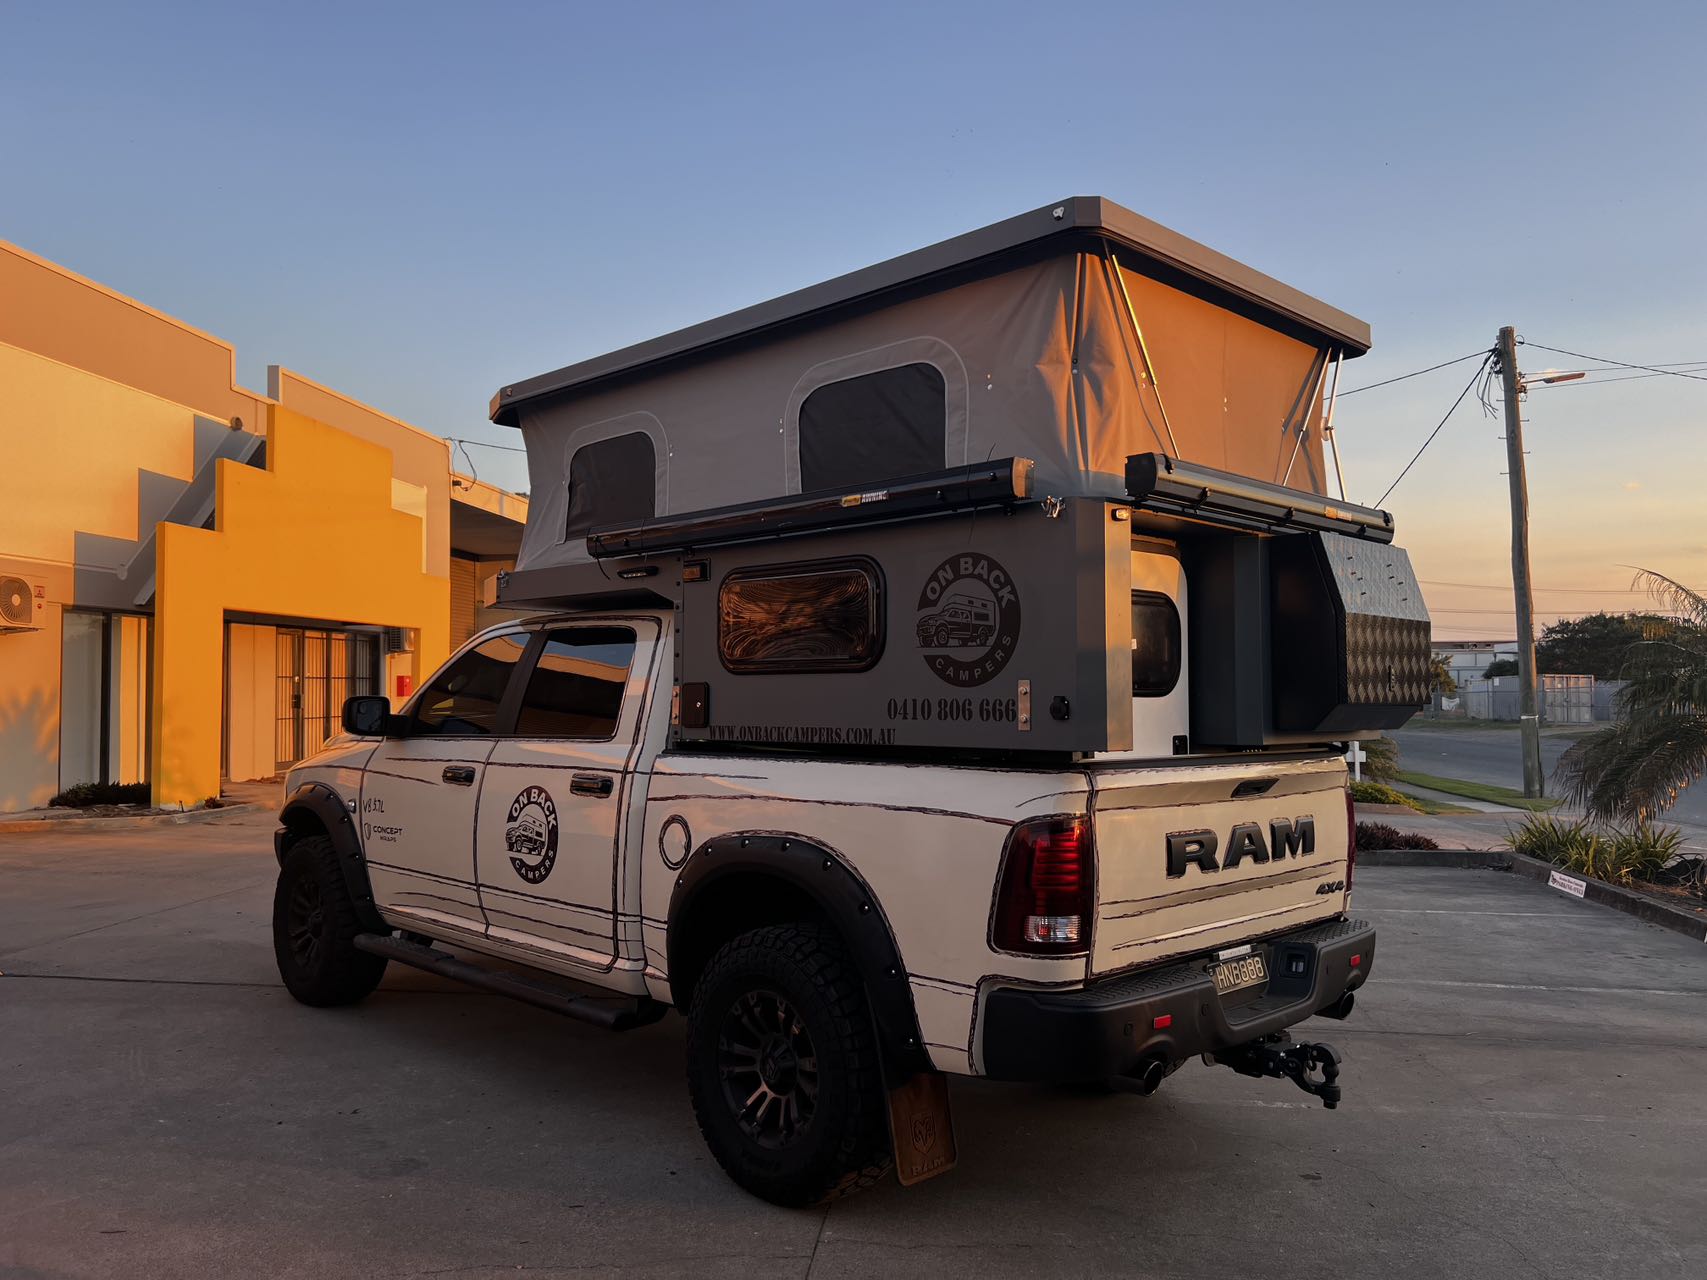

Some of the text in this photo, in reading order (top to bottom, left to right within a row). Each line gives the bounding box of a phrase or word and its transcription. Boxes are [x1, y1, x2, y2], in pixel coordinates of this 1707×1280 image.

[926, 557, 1016, 608] ON BACK
[935, 635, 1011, 681] CAMPERS
[887, 698, 1017, 722] 0410 806 666
[709, 725, 896, 745] WWW.ONBACKCAMPERS.COM.AU
[512, 789, 557, 830] ON BACK
[372, 825, 403, 836] CONCEPT
[1165, 814, 1316, 880] RAM
[515, 850, 554, 879] CAMPERS
